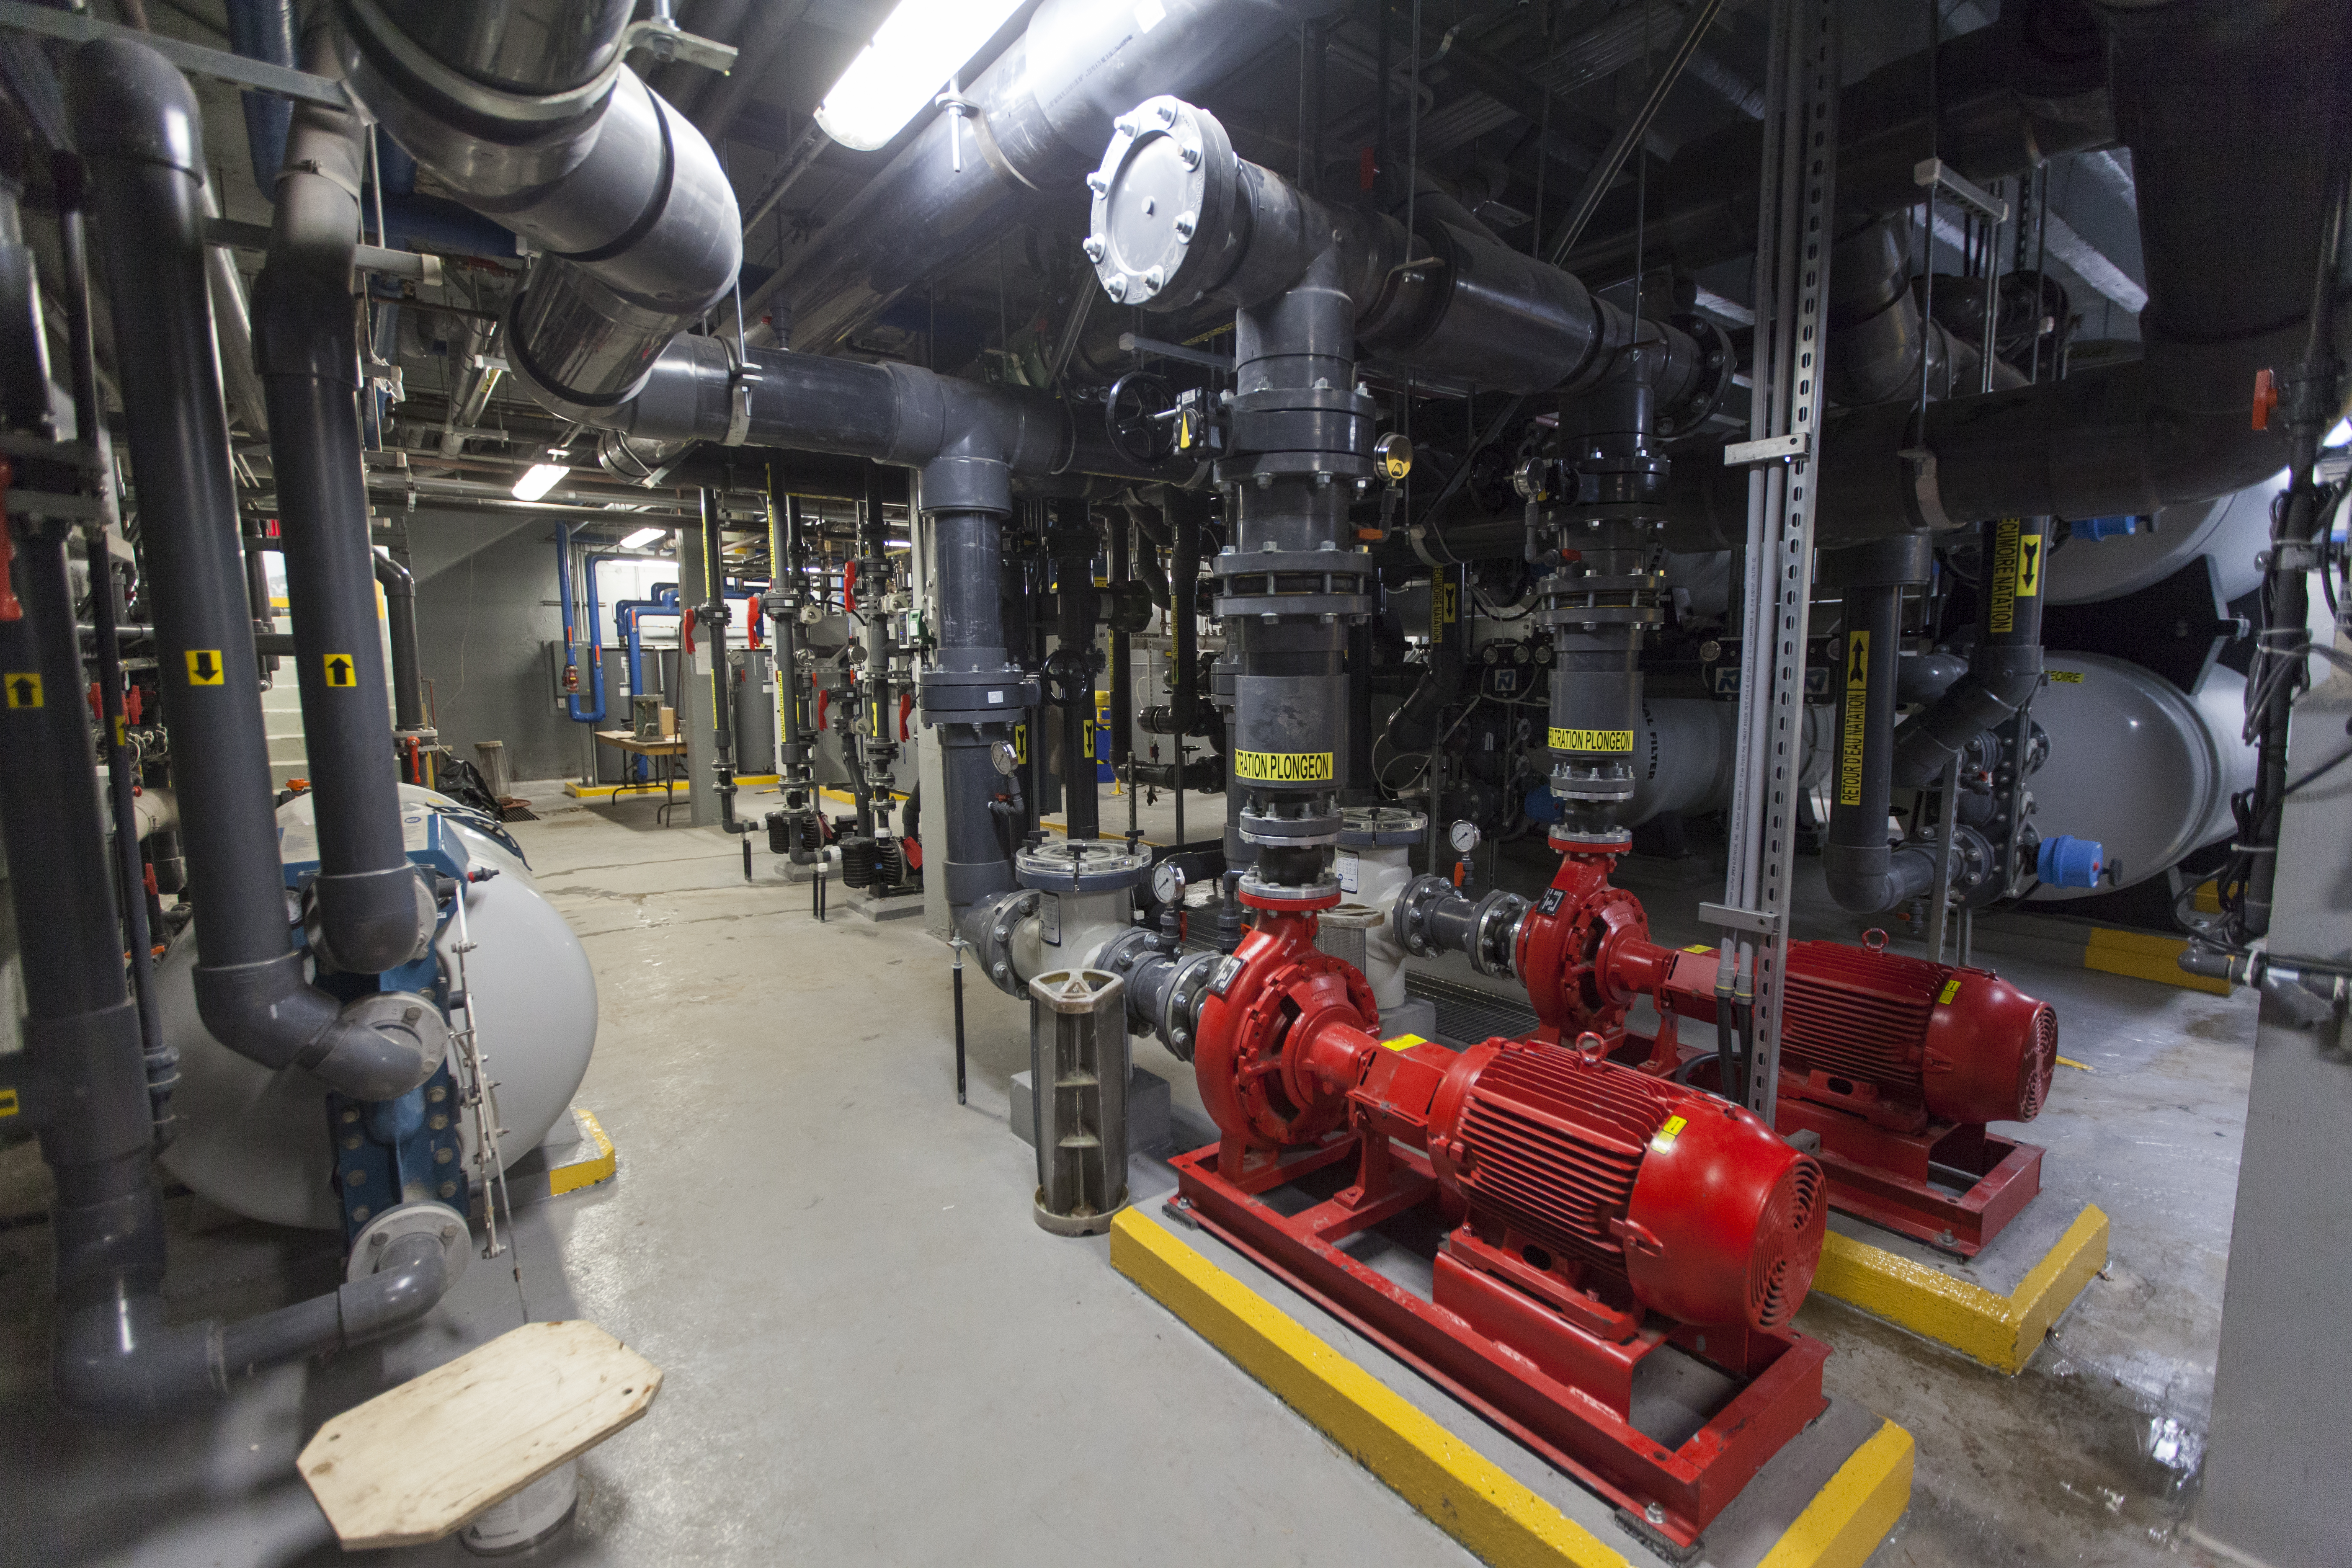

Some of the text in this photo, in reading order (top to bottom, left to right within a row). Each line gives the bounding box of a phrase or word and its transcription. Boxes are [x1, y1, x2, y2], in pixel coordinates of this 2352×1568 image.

[1434, 568, 1442, 605] ECUMOIRE
[1992, 577, 2014, 629] NATATION
[1586, 731, 1630, 750] PLONGEON
[1648, 732, 1658, 780] FILTER
[1842, 695, 1865, 801] RETOUR D'EAU NATATION
[1271, 754, 1328, 779] PLONGEON
